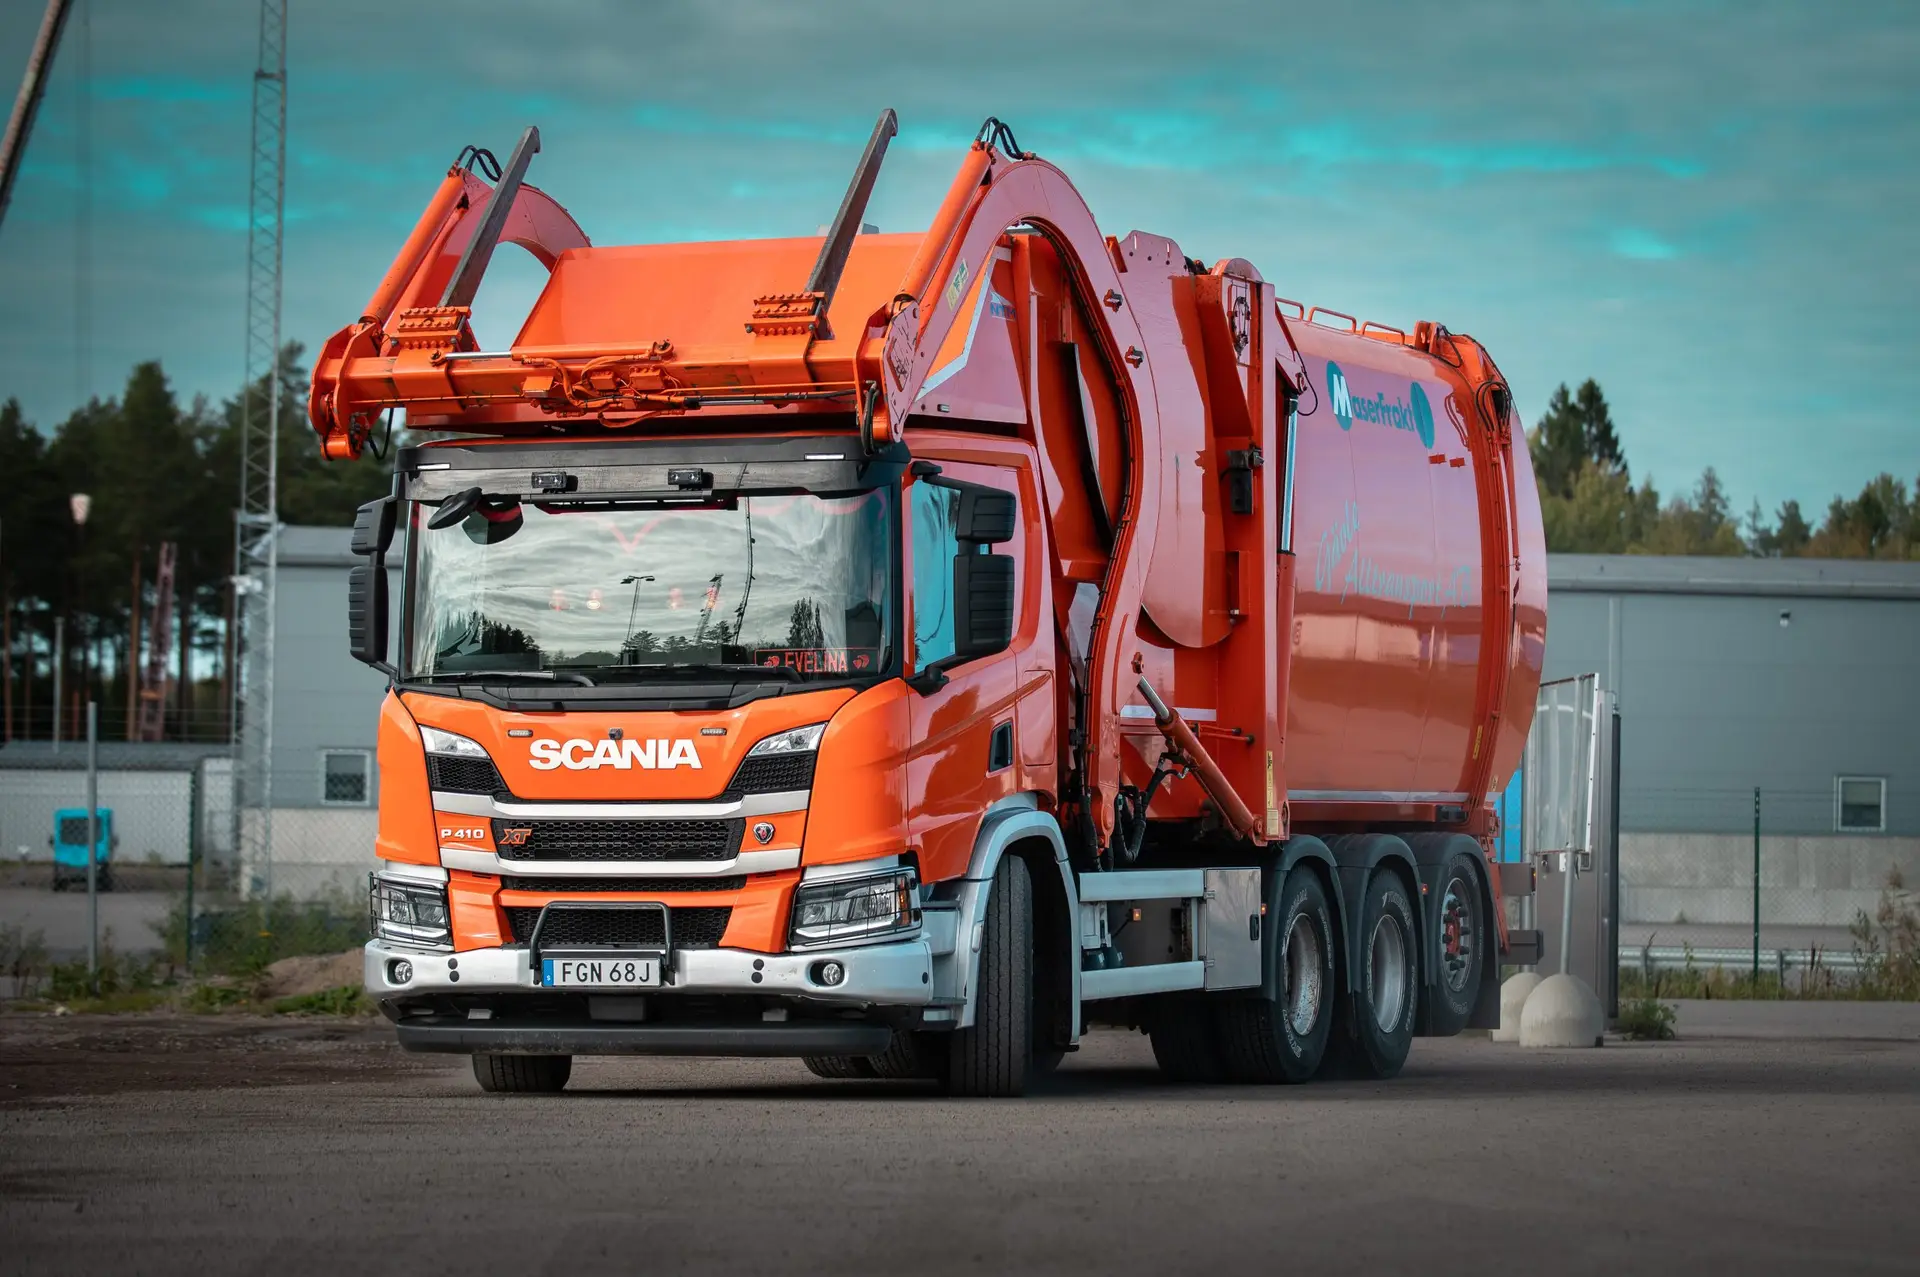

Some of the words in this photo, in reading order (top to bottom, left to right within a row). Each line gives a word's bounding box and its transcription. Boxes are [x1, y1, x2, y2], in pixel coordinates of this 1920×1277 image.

[785, 651, 848, 672] EVELINA
[528, 739, 702, 770] SCANIA
[441, 828, 452, 839] P
[454, 828, 484, 839] 410
[500, 828, 532, 844] XT
[562, 962, 602, 982] FGN
[609, 962, 650, 982] 68J
